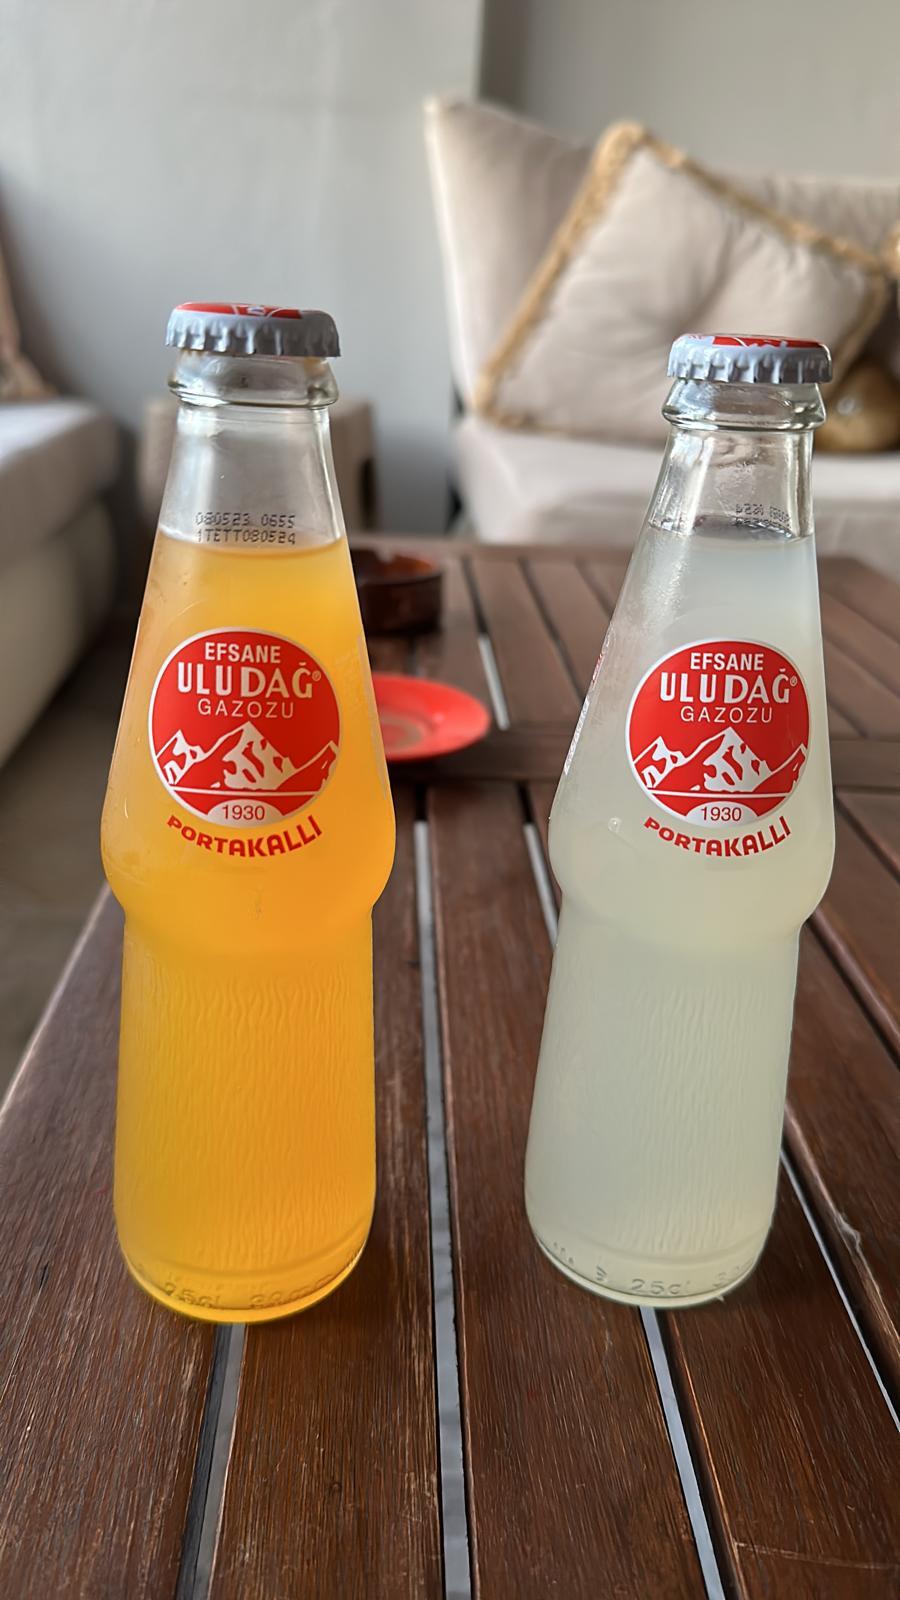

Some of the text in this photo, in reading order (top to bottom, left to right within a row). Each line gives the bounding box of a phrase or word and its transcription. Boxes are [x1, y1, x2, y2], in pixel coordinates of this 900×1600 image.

[204, 641, 281, 664] EFSANE
[690, 652, 765, 672] EFSANE
[197, 698, 294, 719] GAZOZU
[680, 705, 773, 724] GAZOZU
[221, 804, 266, 821] 1930
[700, 806, 743, 822] 1930
[165, 814, 323, 858] PORTAKALLI
[643, 815, 792, 858] PORTAKALLI
